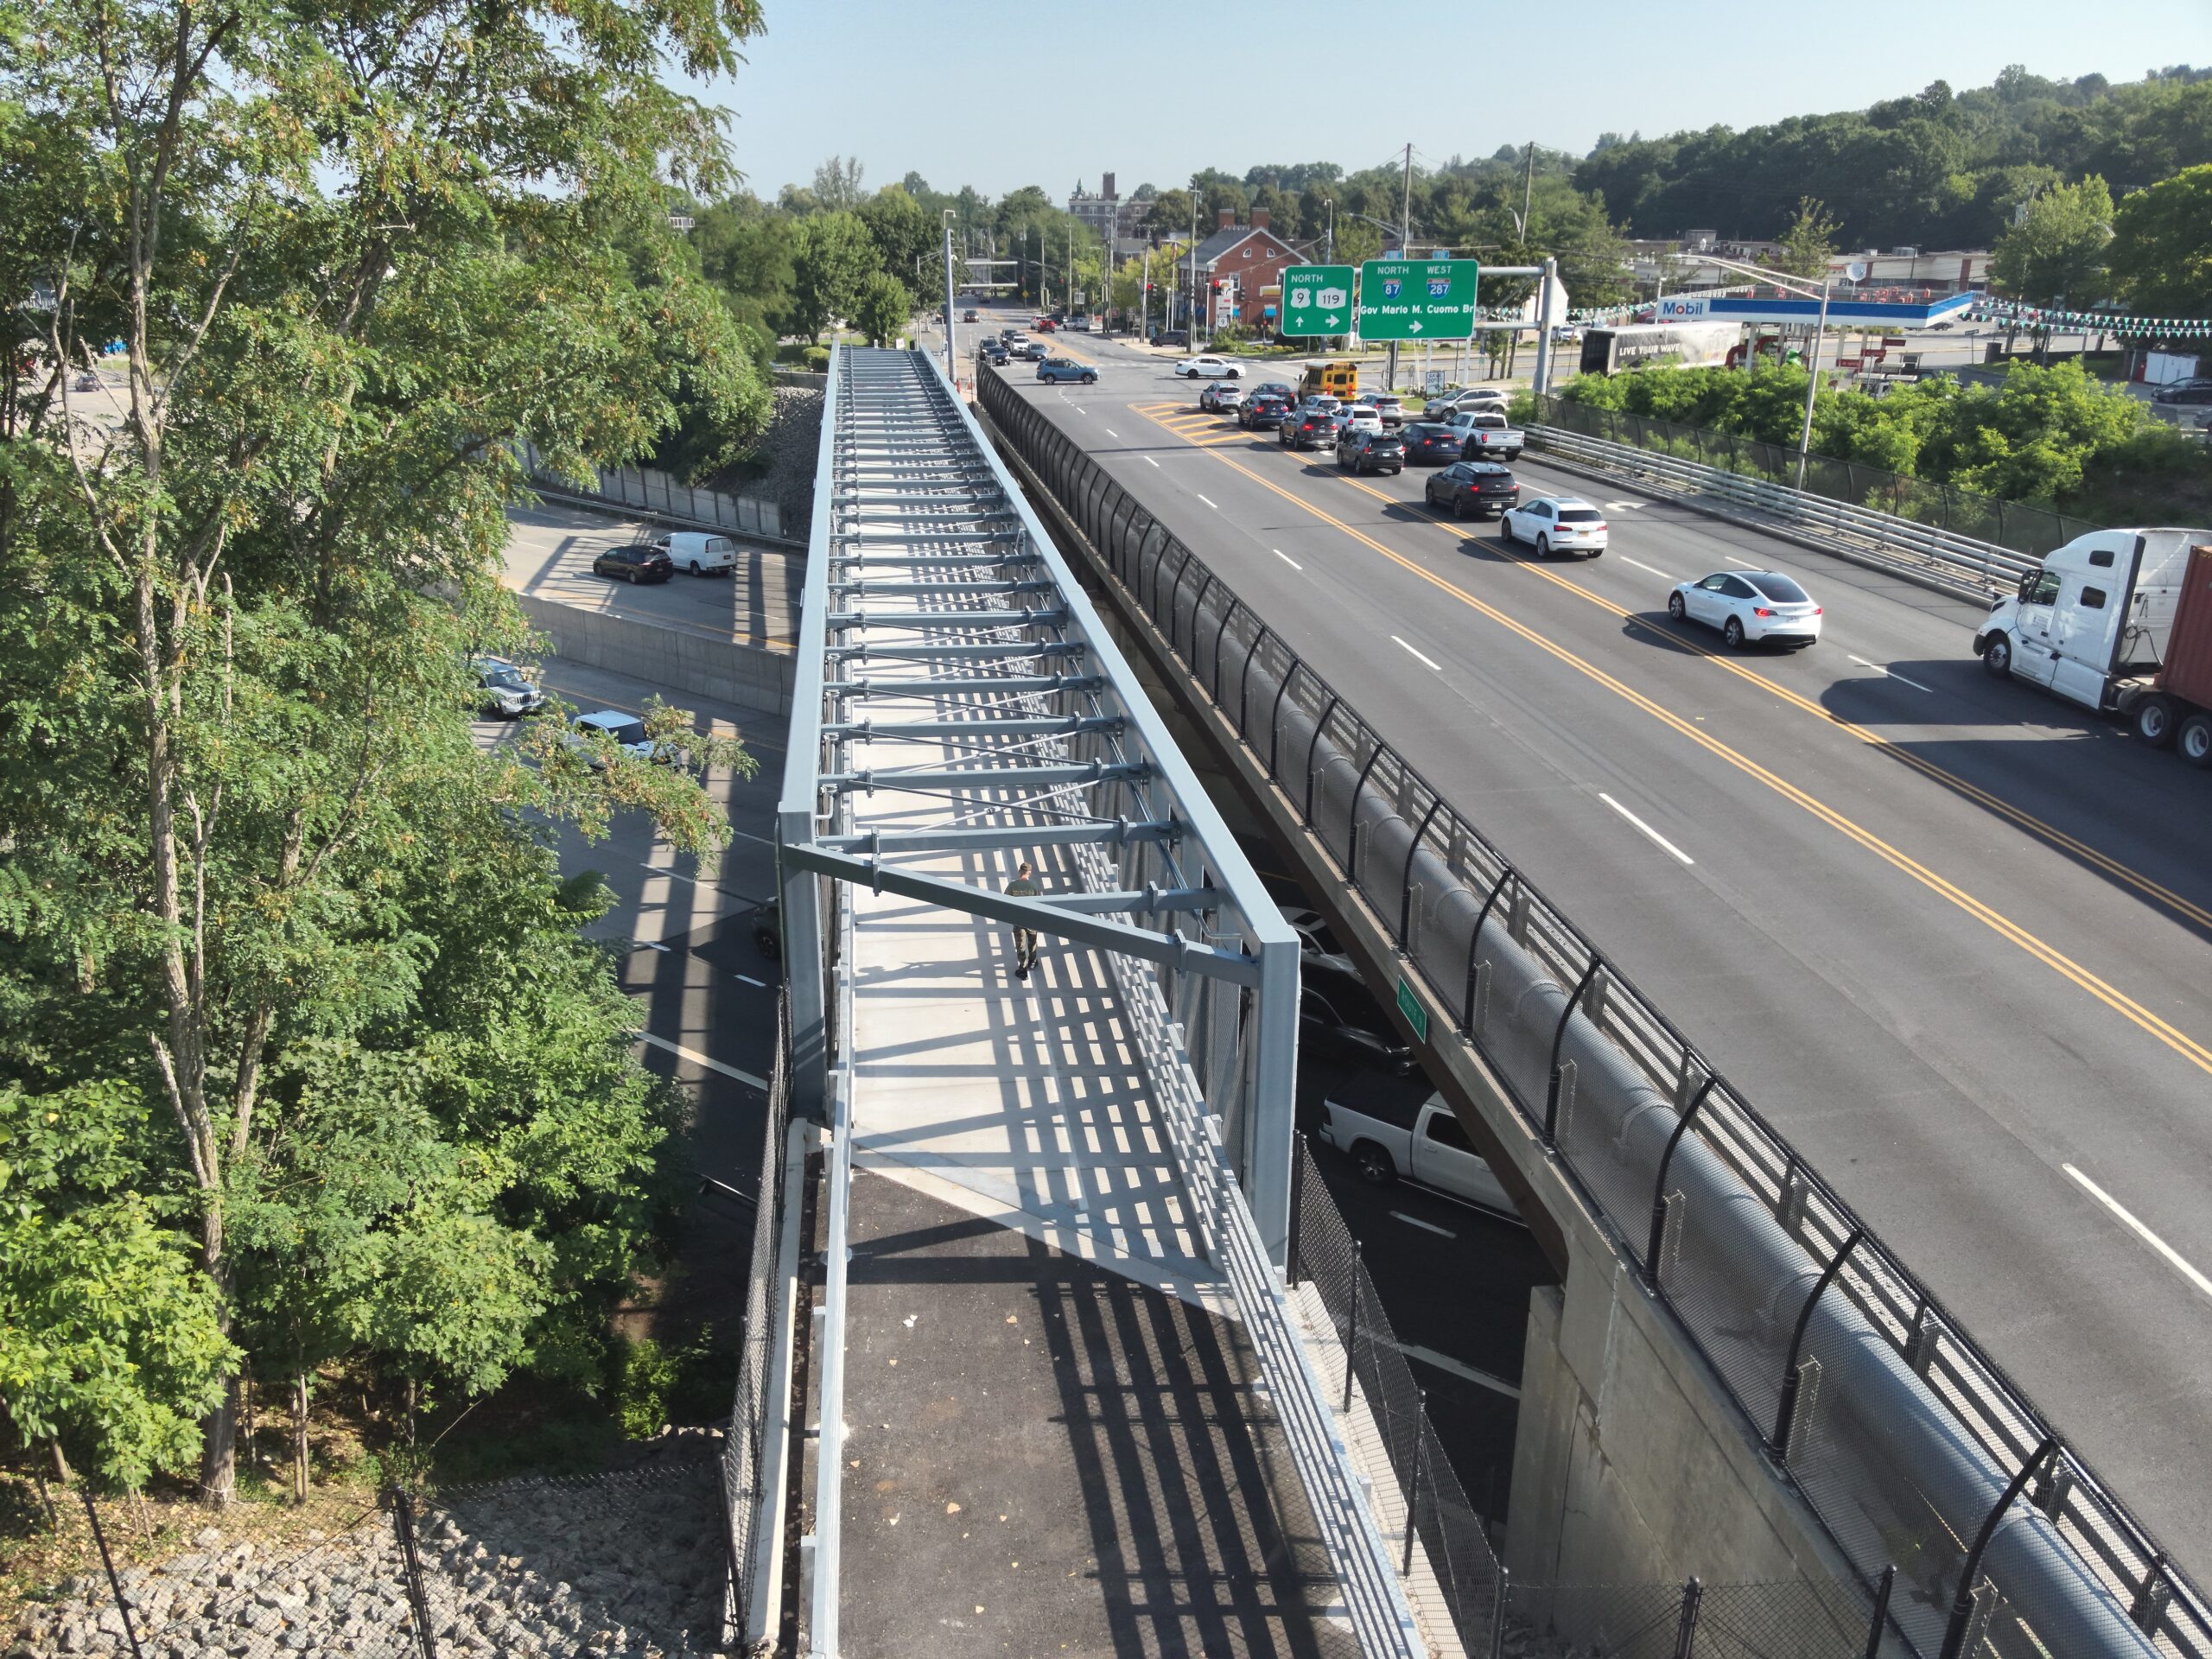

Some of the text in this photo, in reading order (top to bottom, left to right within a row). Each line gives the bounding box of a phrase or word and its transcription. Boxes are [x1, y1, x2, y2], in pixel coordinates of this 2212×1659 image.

[1377, 265, 1452, 275] NORTH WEST
[1291, 274, 1323, 283] NORTH
[1385, 284, 1449, 295] 87 287
[1297, 292, 1339, 304] 9 119
[1360, 304, 1474, 315] Gov Mario M. Cuomo Br
[1662, 302, 1703, 315] Mobil
[1618, 346, 1637, 356] LIVE
[1660, 343, 1681, 353] WAVE
[1401, 989, 1418, 1020] ROUTE
